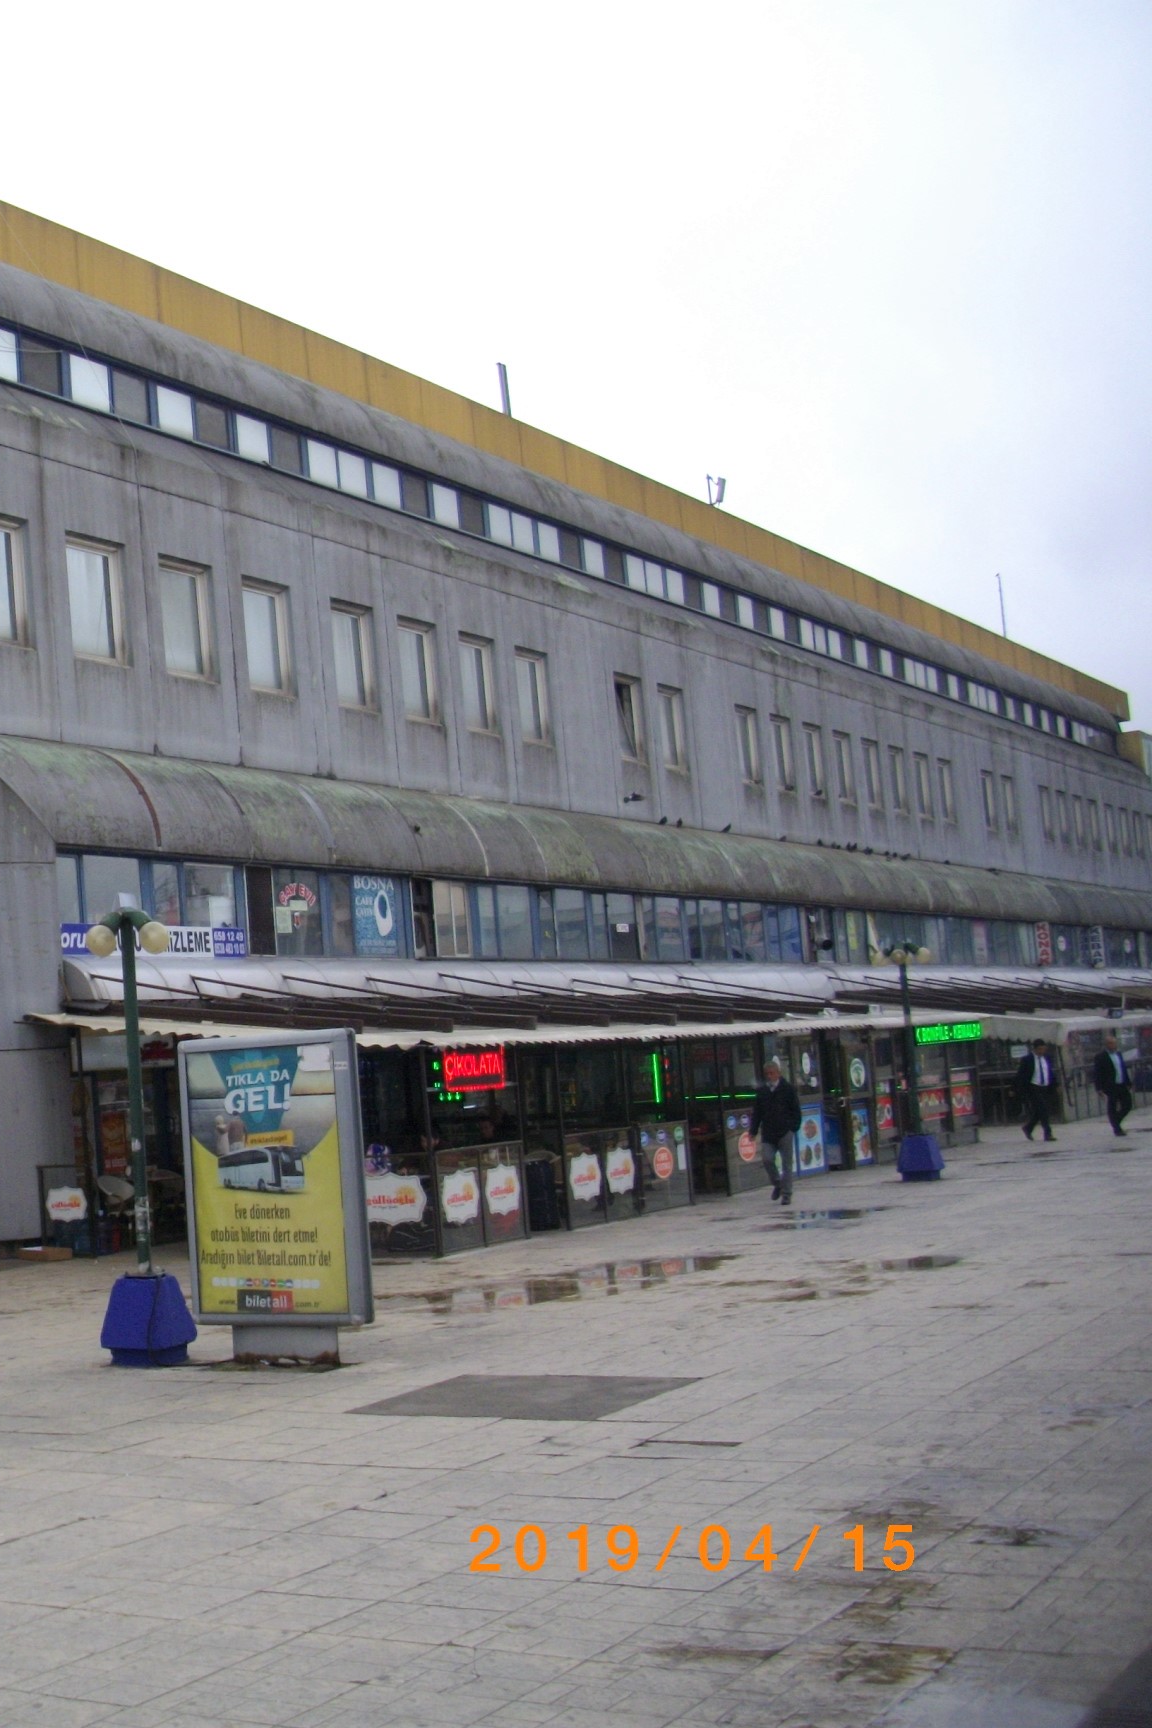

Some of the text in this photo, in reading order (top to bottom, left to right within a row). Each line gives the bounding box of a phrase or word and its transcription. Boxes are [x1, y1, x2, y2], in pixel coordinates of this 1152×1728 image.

[353, 875, 394, 890] BOSNA
[227, 931, 235, 941] 12
[1036, 923, 1050, 965] KONAK
[226, 1069, 290, 1087] TIKLA DA
[224, 1083, 291, 1114] GEL!
[234, 1203, 290, 1220] Eve dönerken
[211, 1227, 318, 1242] otobüs biletini dert etme!
[201, 1250, 234, 1269] Aradığın
[237, 1251, 255, 1265] bilet
[246, 1295, 287, 1308] biletall
